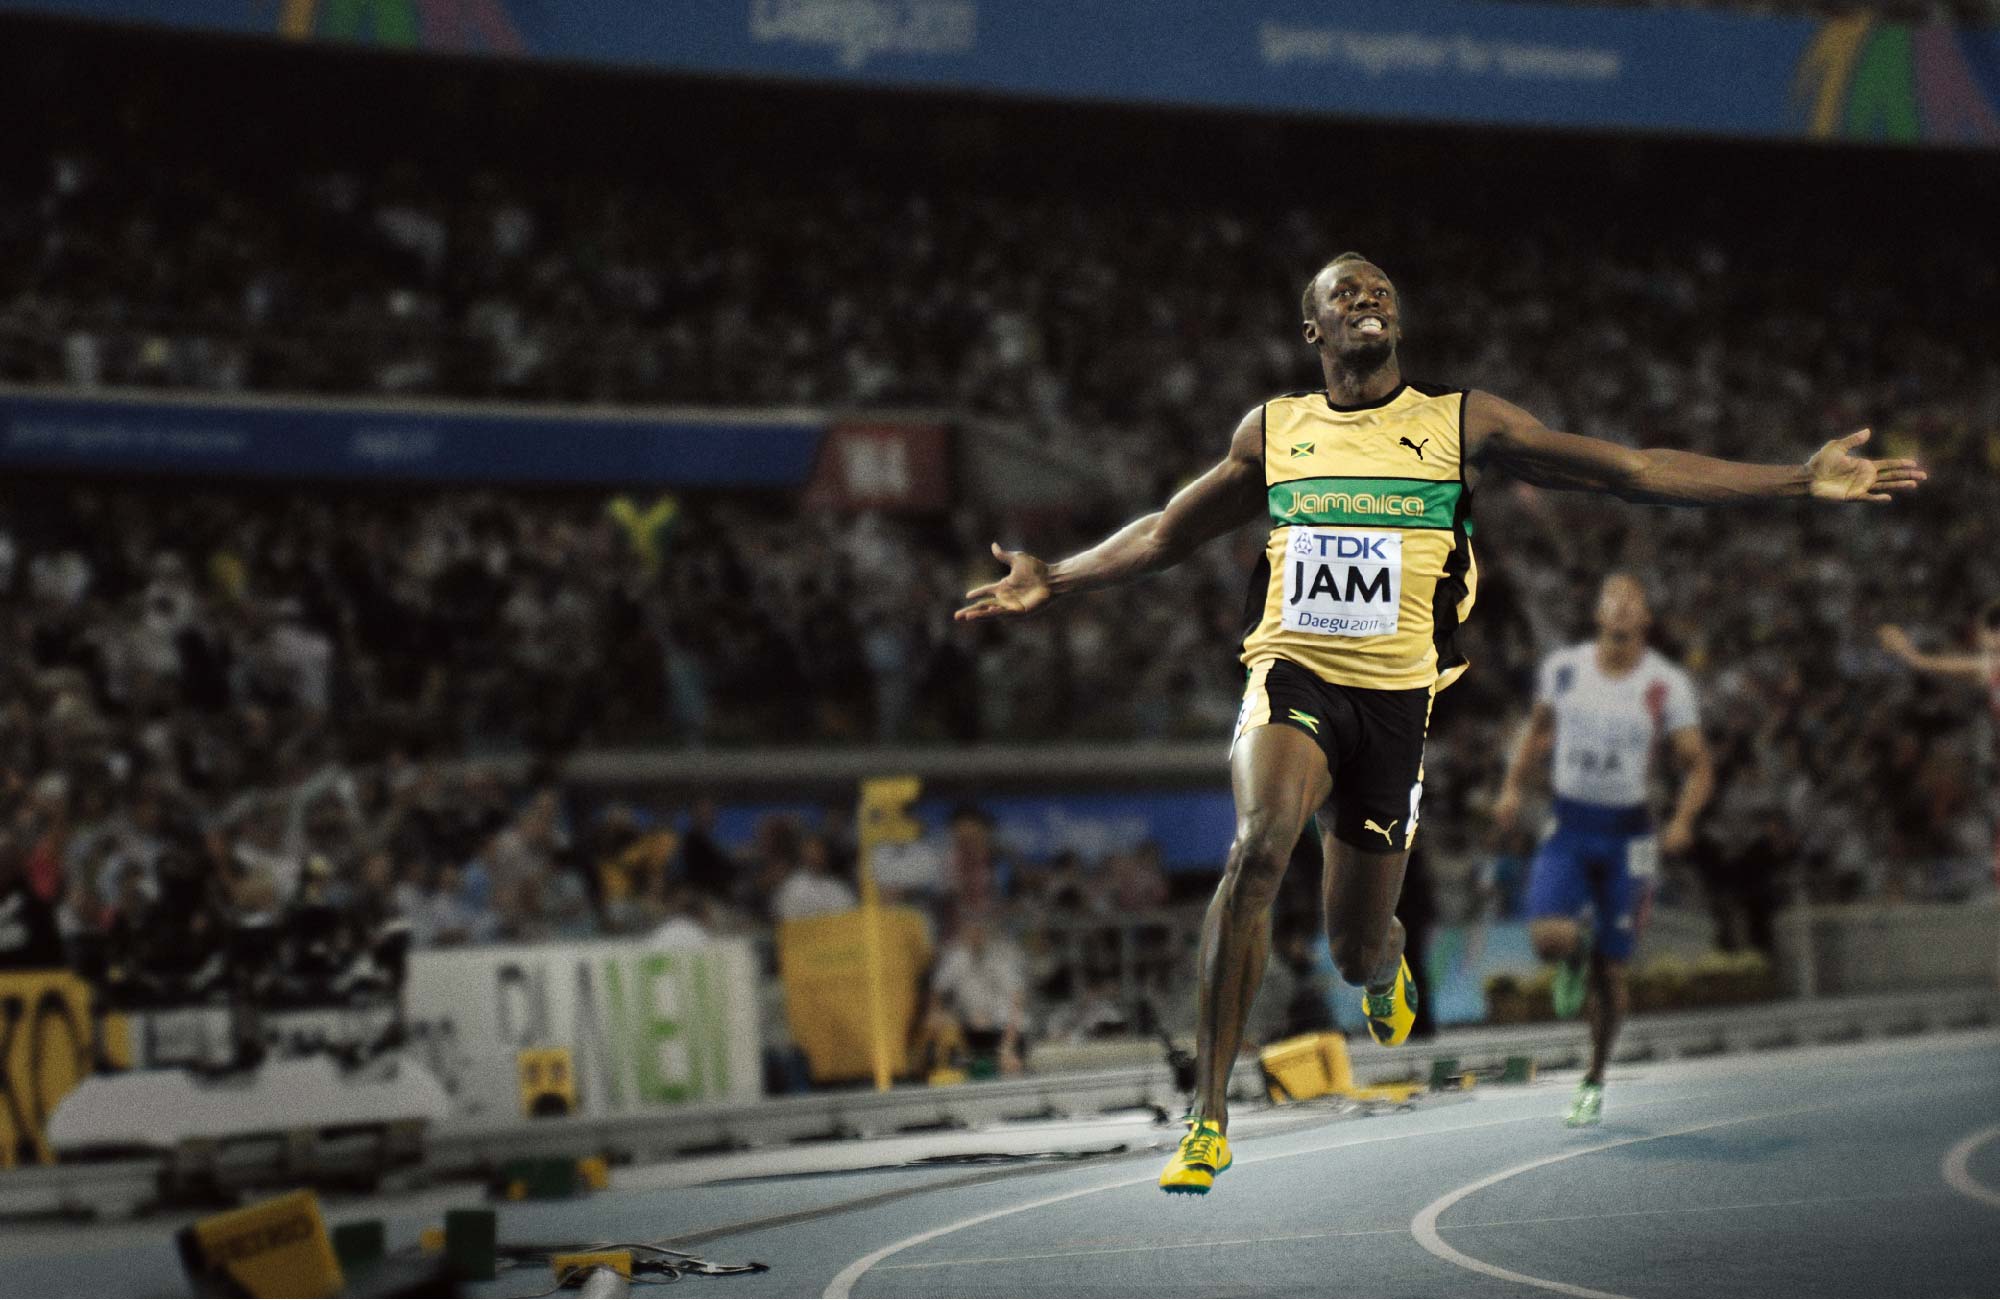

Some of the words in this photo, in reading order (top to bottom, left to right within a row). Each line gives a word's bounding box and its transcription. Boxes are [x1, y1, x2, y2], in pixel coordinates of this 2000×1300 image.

[1286, 492, 1424, 516] Jamaica
[1313, 534, 1388, 559] TDK
[1290, 560, 1392, 606] JAM
[1298, 612, 1349, 634] Daegu
[1350, 619, 1379, 631] 2011
